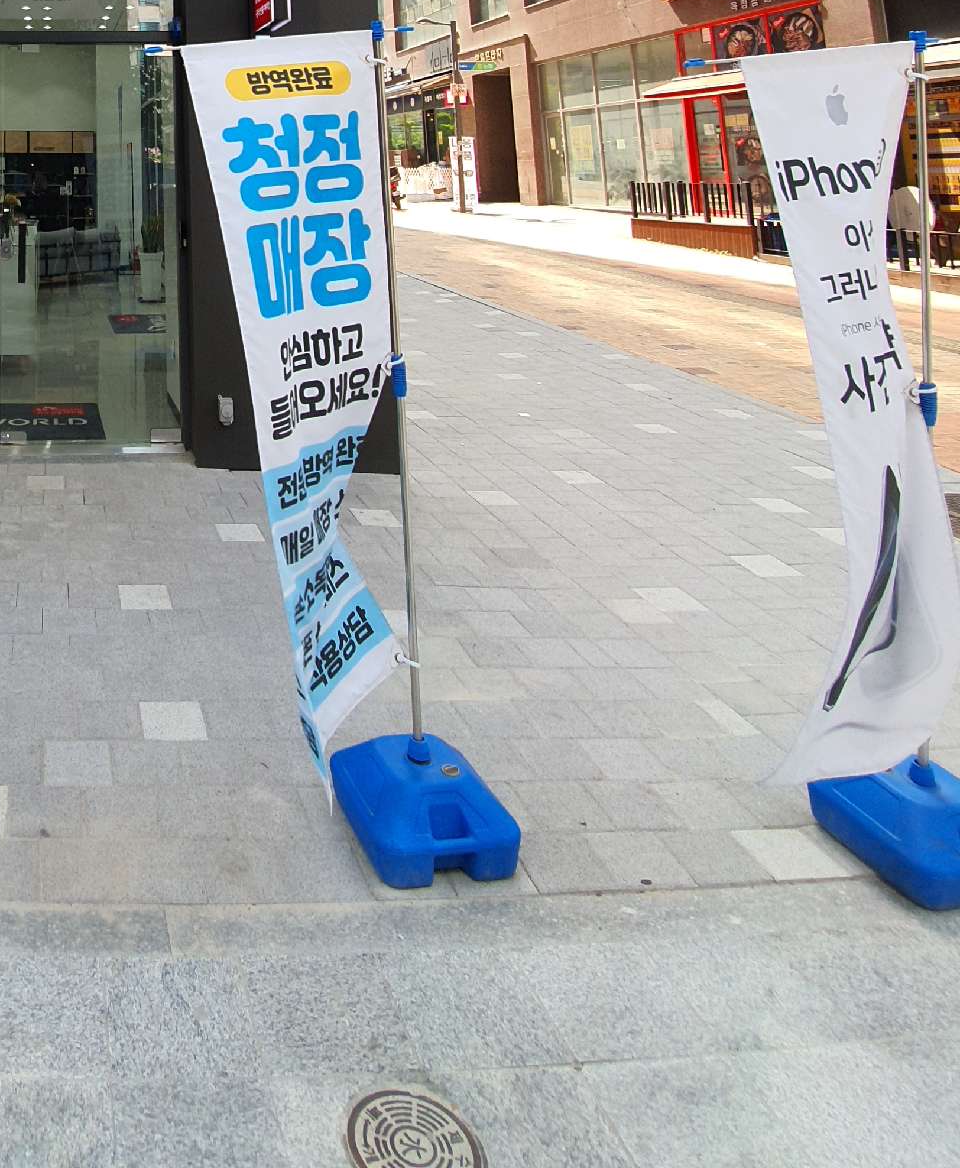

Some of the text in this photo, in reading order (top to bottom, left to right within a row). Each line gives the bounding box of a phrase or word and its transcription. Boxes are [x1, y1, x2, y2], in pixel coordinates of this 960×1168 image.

[246, 66, 333, 95] 방역완료
[222, 110, 364, 212] 청정
[246, 207, 372, 320] 매장
[279, 323, 364, 381] 안심하고
